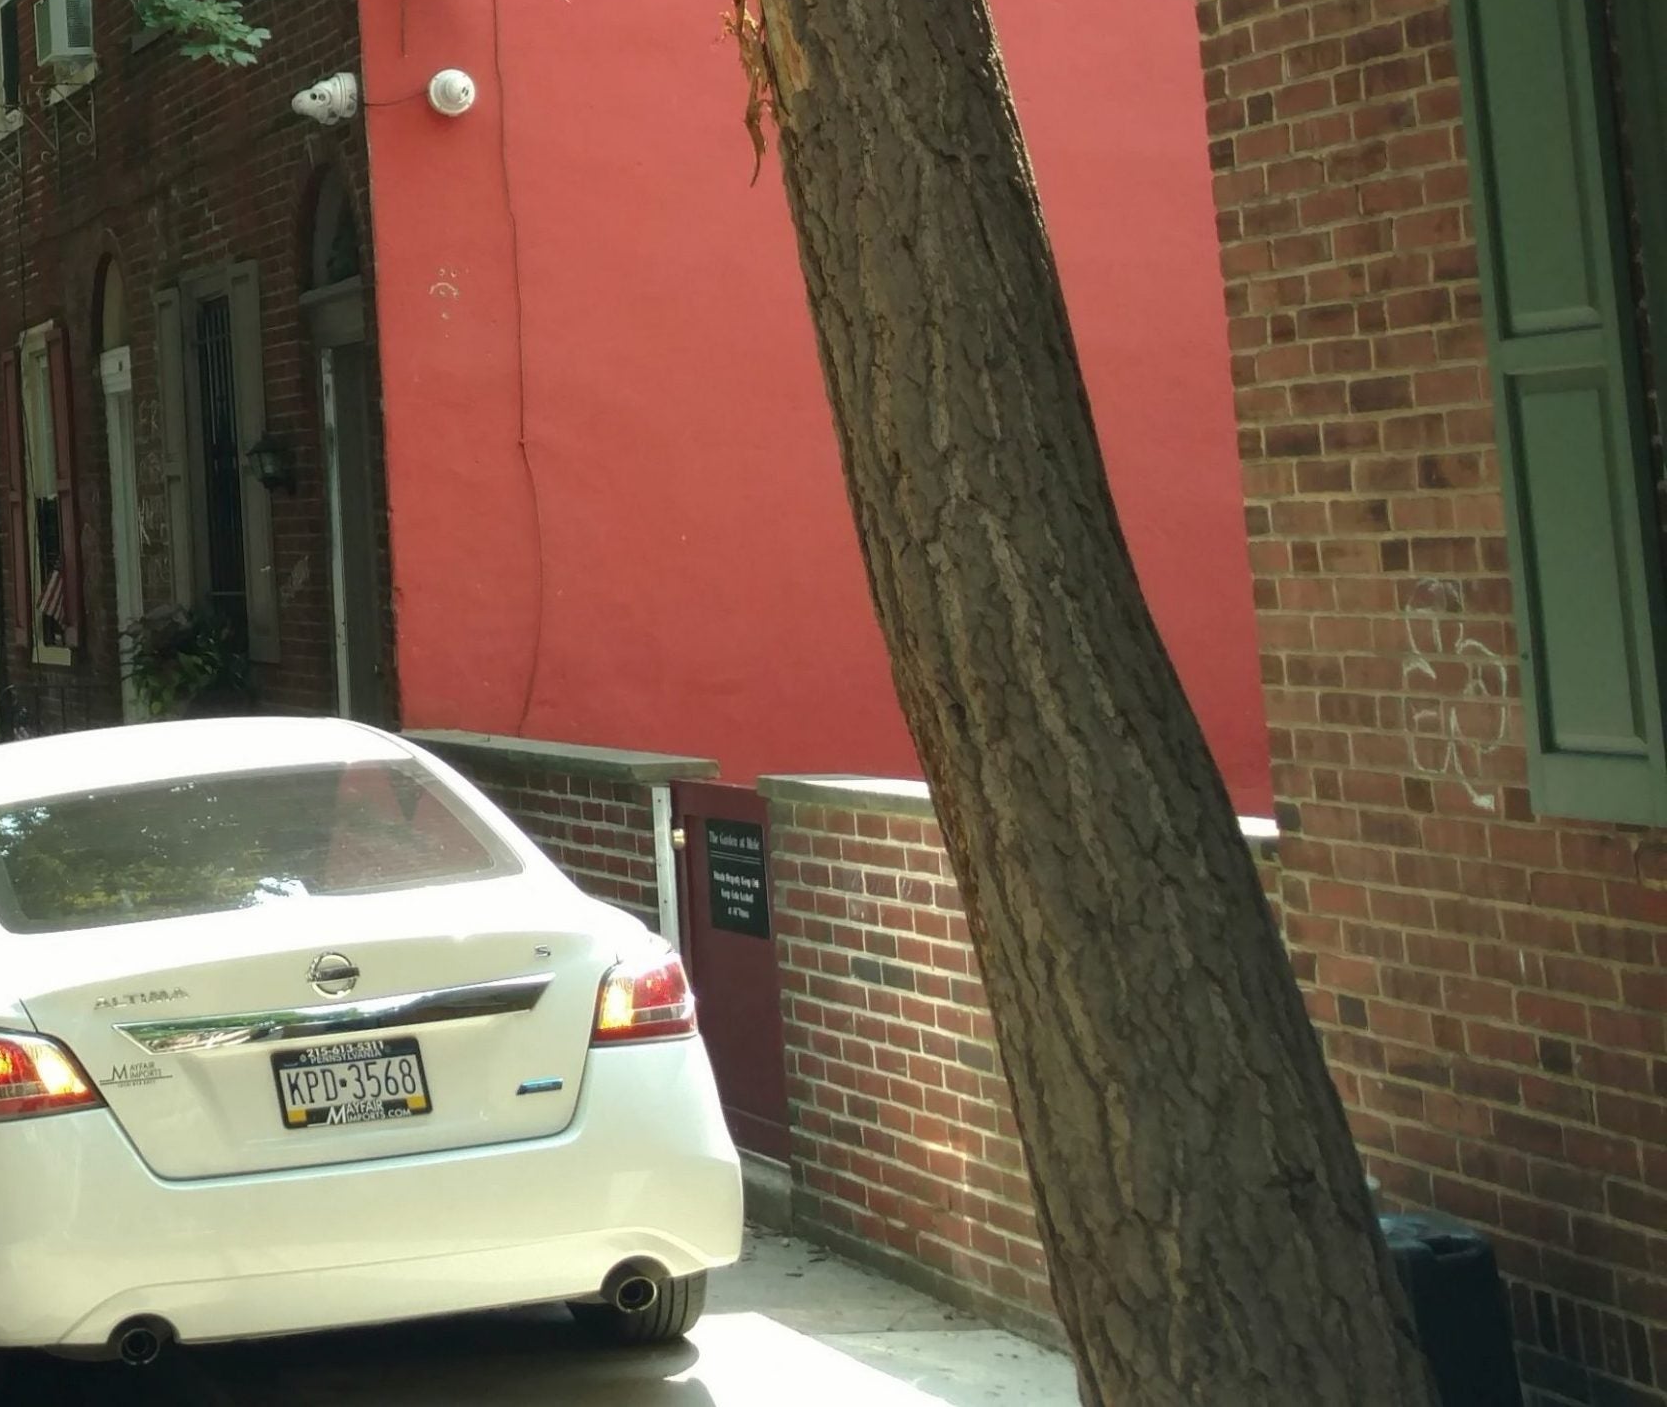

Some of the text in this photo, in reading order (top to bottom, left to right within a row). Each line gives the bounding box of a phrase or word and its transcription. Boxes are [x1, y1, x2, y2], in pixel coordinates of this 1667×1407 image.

[94, 987, 190, 1010] ALTIMA
[306, 1040, 385, 1058] 215-613-5311
[310, 1049, 383, 1064] PENNSYLVANIA
[326, 1099, 384, 1124] MAYFAIR
